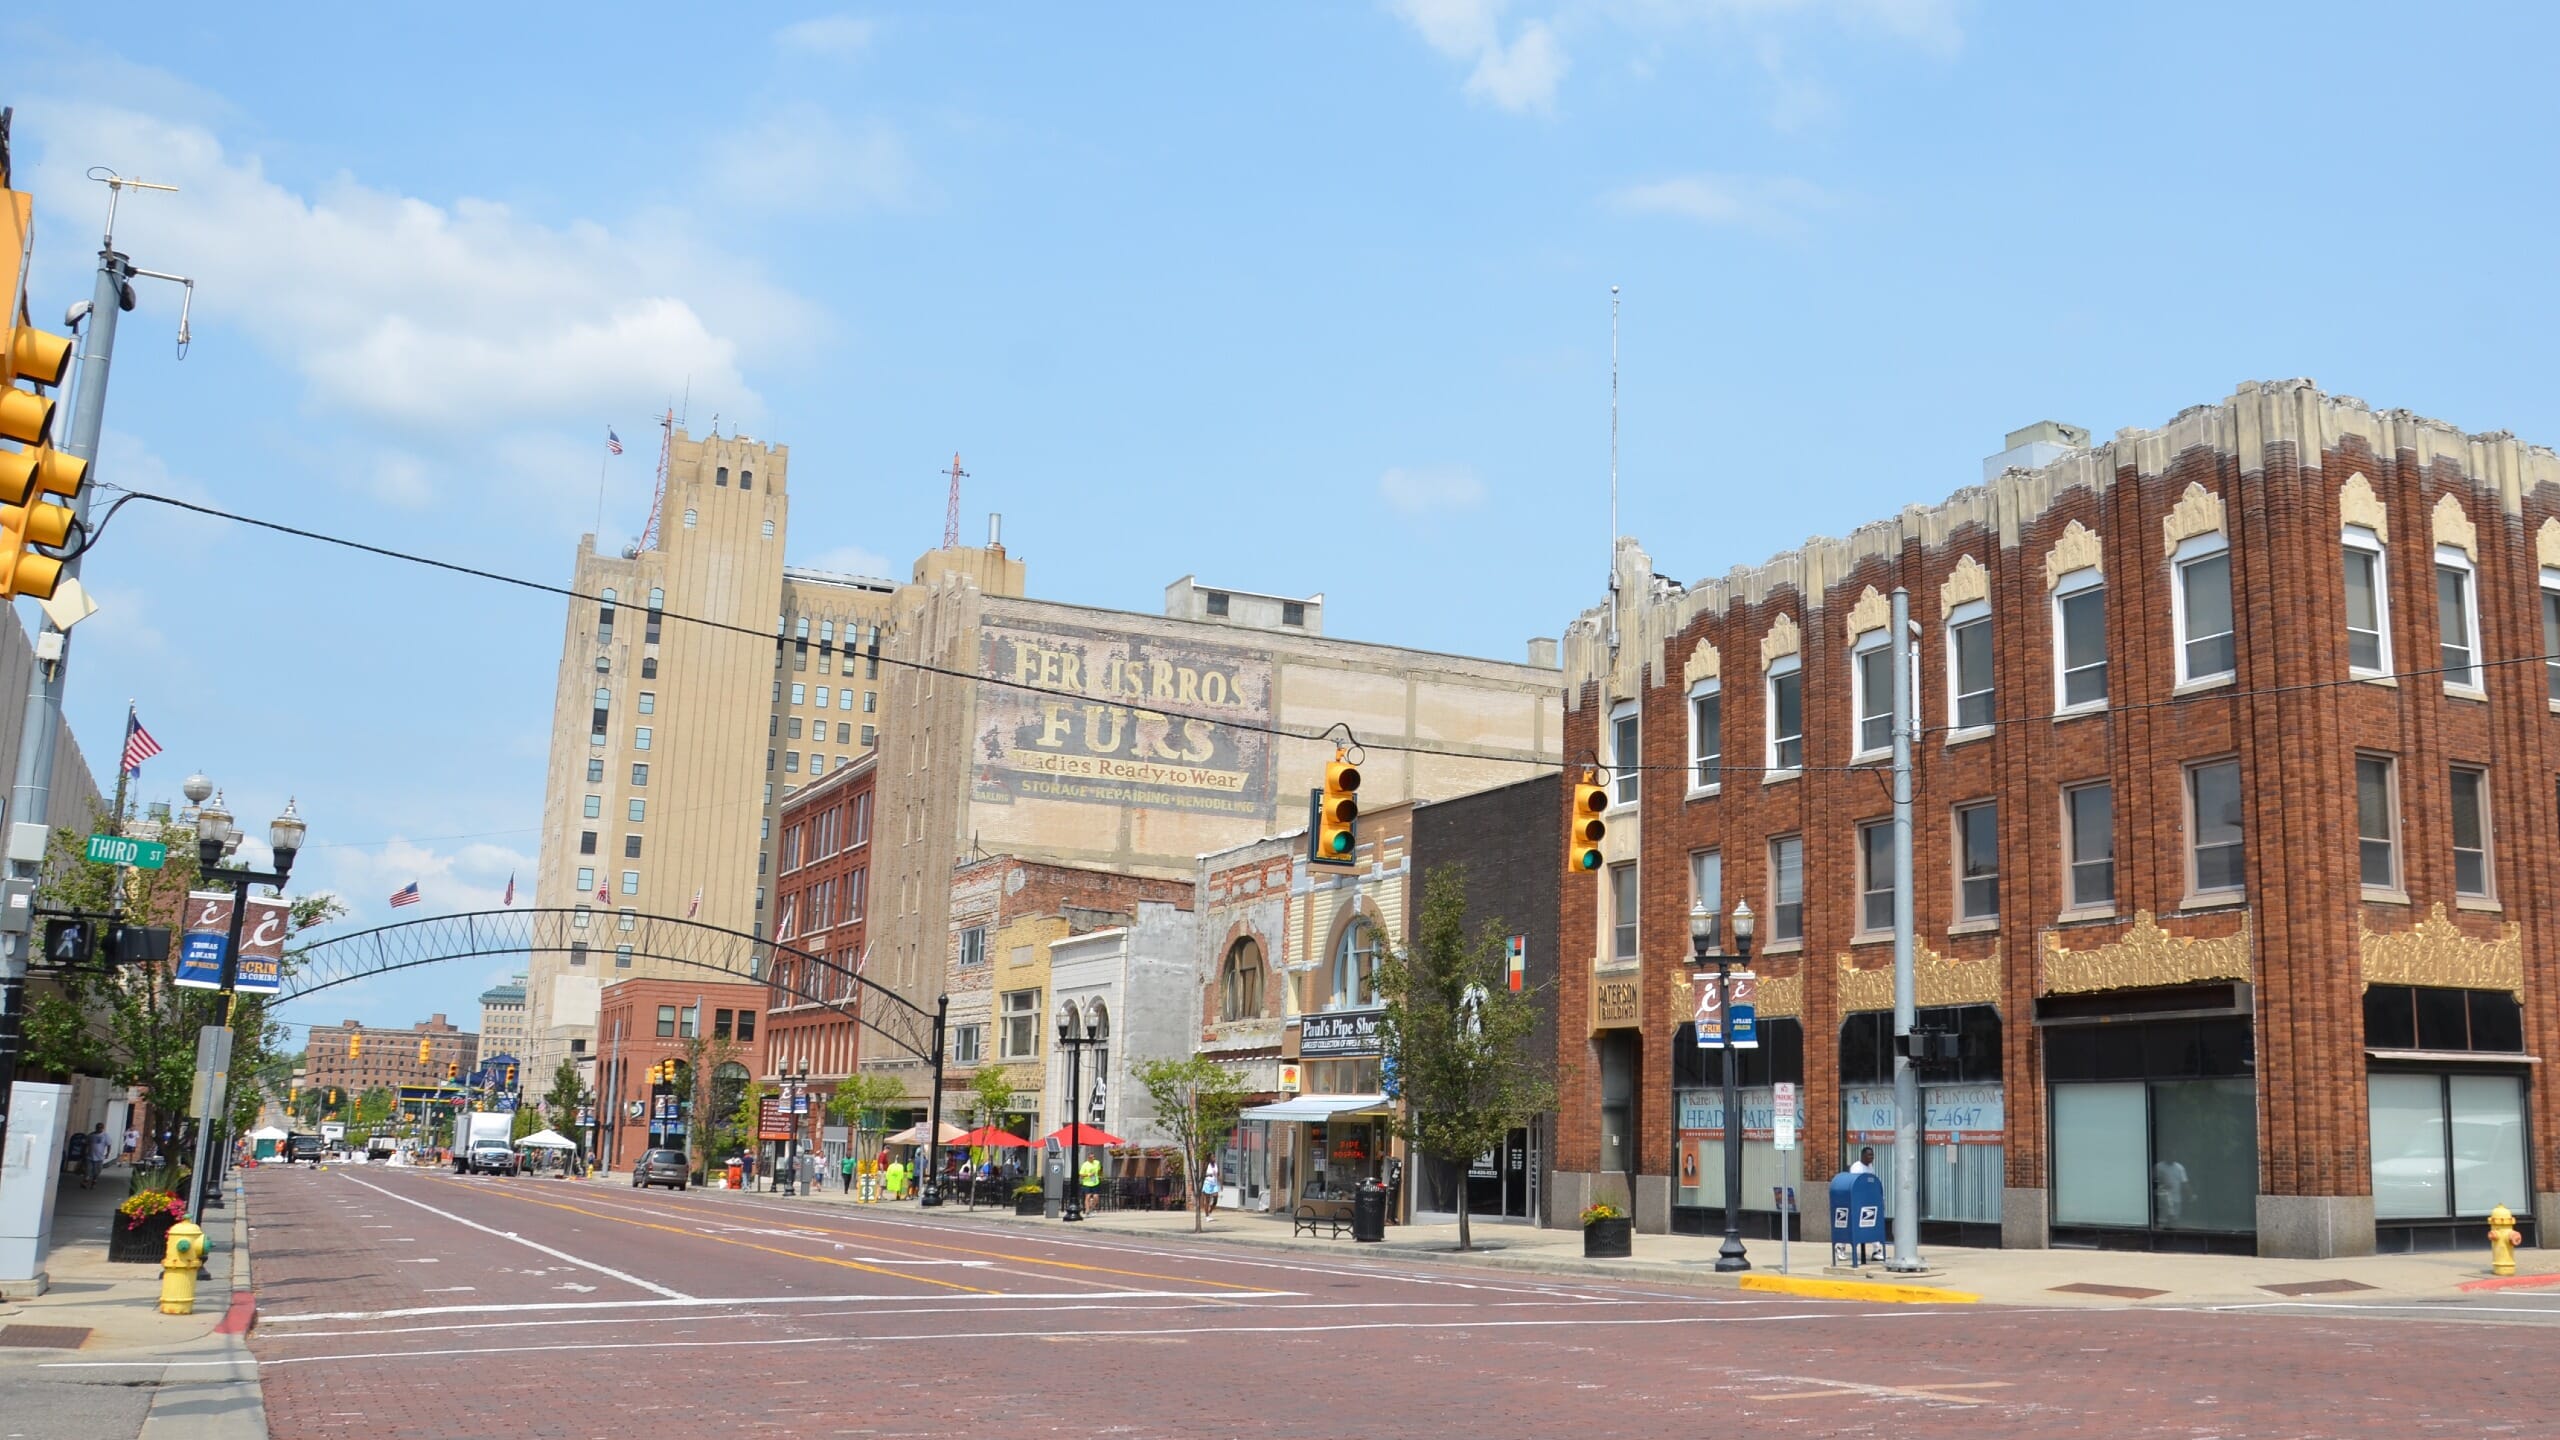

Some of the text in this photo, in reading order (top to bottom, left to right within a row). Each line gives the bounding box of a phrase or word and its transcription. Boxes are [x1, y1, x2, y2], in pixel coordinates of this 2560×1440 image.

[1149, 658, 1248, 709] BROS
[1036, 699, 1215, 763] FURS
[1022, 780, 1255, 813] STORAGE REPAIRING REMODELING
[90, 838, 162, 862] THIRD ST
[239, 972, 278, 981] IS COMING
[245, 961, 277, 974] CRIM
[1598, 983, 1638, 1005] PATERSON
[1601, 1005, 1634, 1019] BUILDING
[1302, 1020, 1330, 1037] Paul's
[1332, 1018, 1354, 1038] Pipe
[1318, 1039, 1339, 1049] COLLECTION
[1686, 1108, 1805, 1128] HEADARTS
